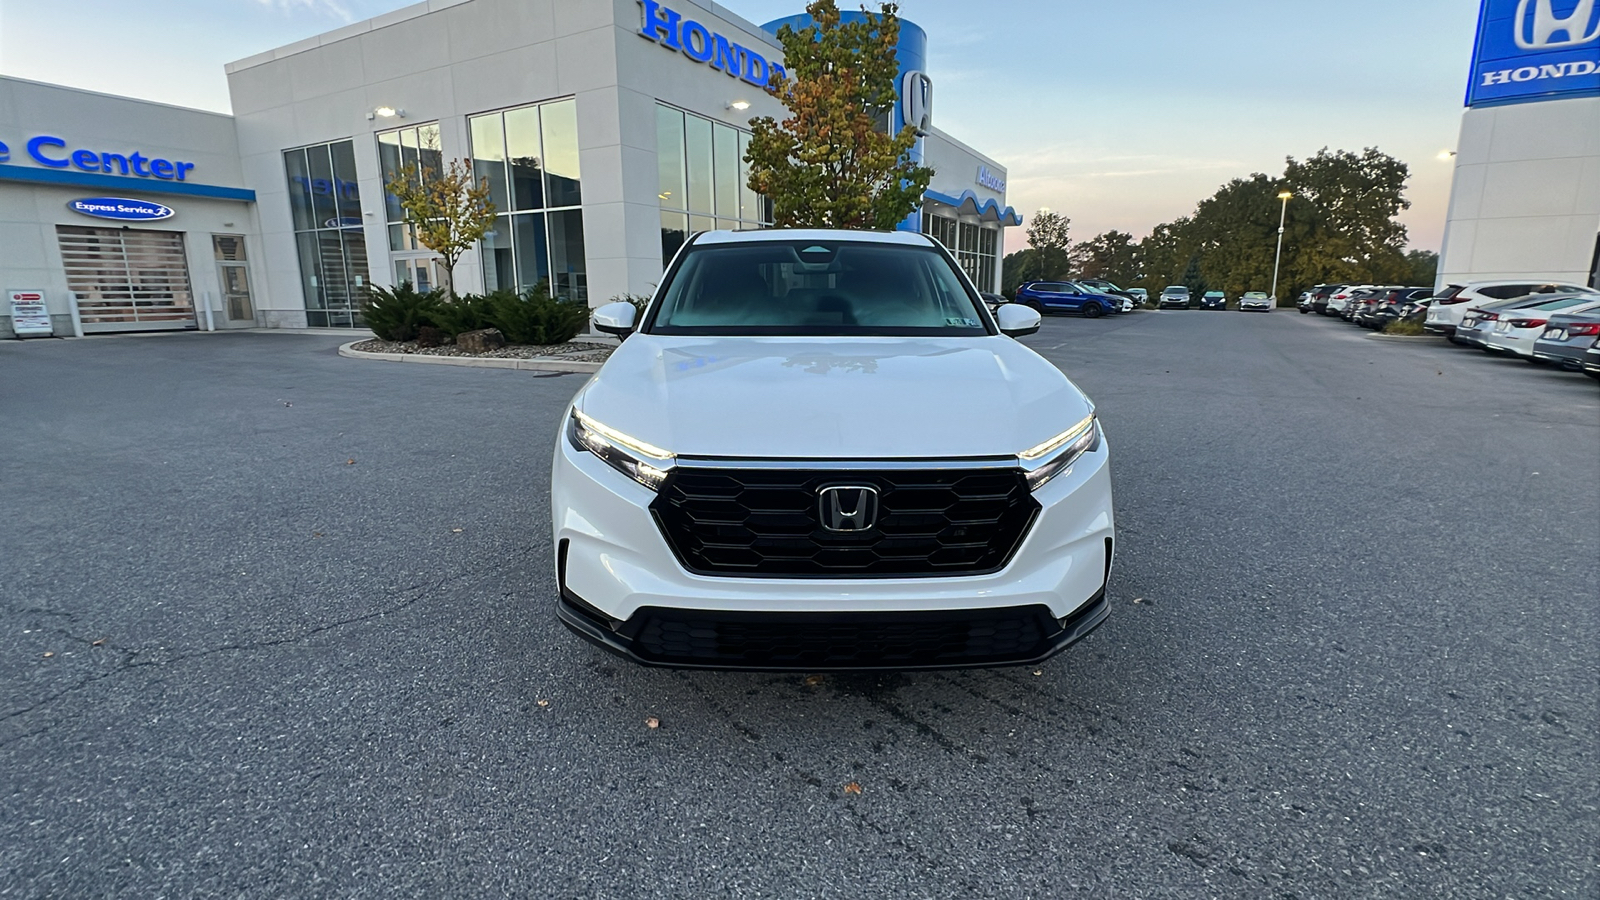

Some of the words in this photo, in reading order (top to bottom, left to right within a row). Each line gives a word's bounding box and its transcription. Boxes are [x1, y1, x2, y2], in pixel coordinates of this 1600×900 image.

[1481, 60, 1600, 86] HOND
[27, 135, 194, 181] Center
[75, 202, 116, 212] Express
[117, 205, 154, 214] Service
